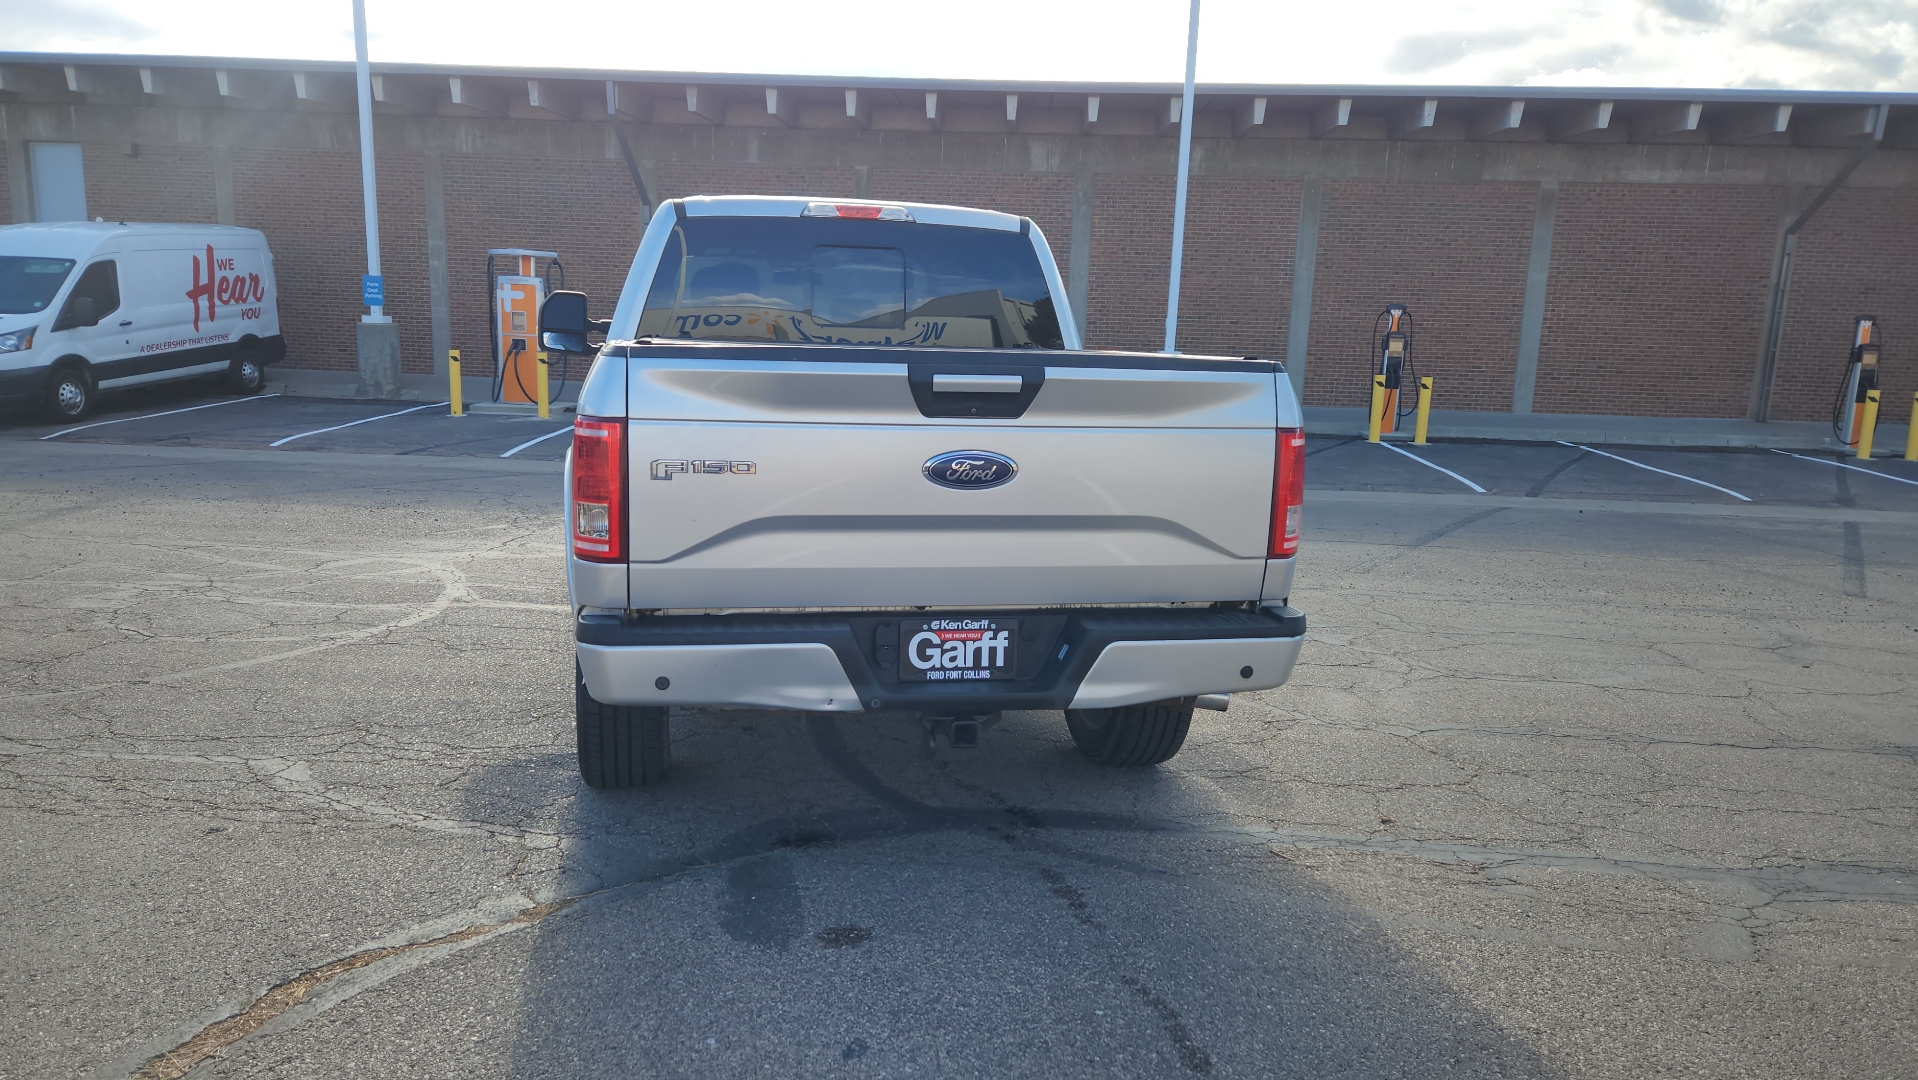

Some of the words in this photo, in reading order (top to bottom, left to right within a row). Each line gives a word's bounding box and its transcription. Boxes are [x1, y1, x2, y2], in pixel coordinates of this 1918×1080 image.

[216, 258, 234, 271] WE
[185, 243, 265, 333] Hear
[240, 306, 261, 320] YOU
[140, 345, 145, 354] A
[146, 339, 187, 353] DEALERSHIP
[188, 338, 204, 346] THAT
[204, 333, 230, 343] LISTENS
[946, 459, 997, 480] Ford
[940, 619, 962, 630] Ken
[962, 619, 989, 630] Garff
[908, 630, 1009, 670] Garff
[927, 671, 944, 680] FORD
[945, 671, 962, 679] FORT
[963, 670, 991, 679] COLLINS
